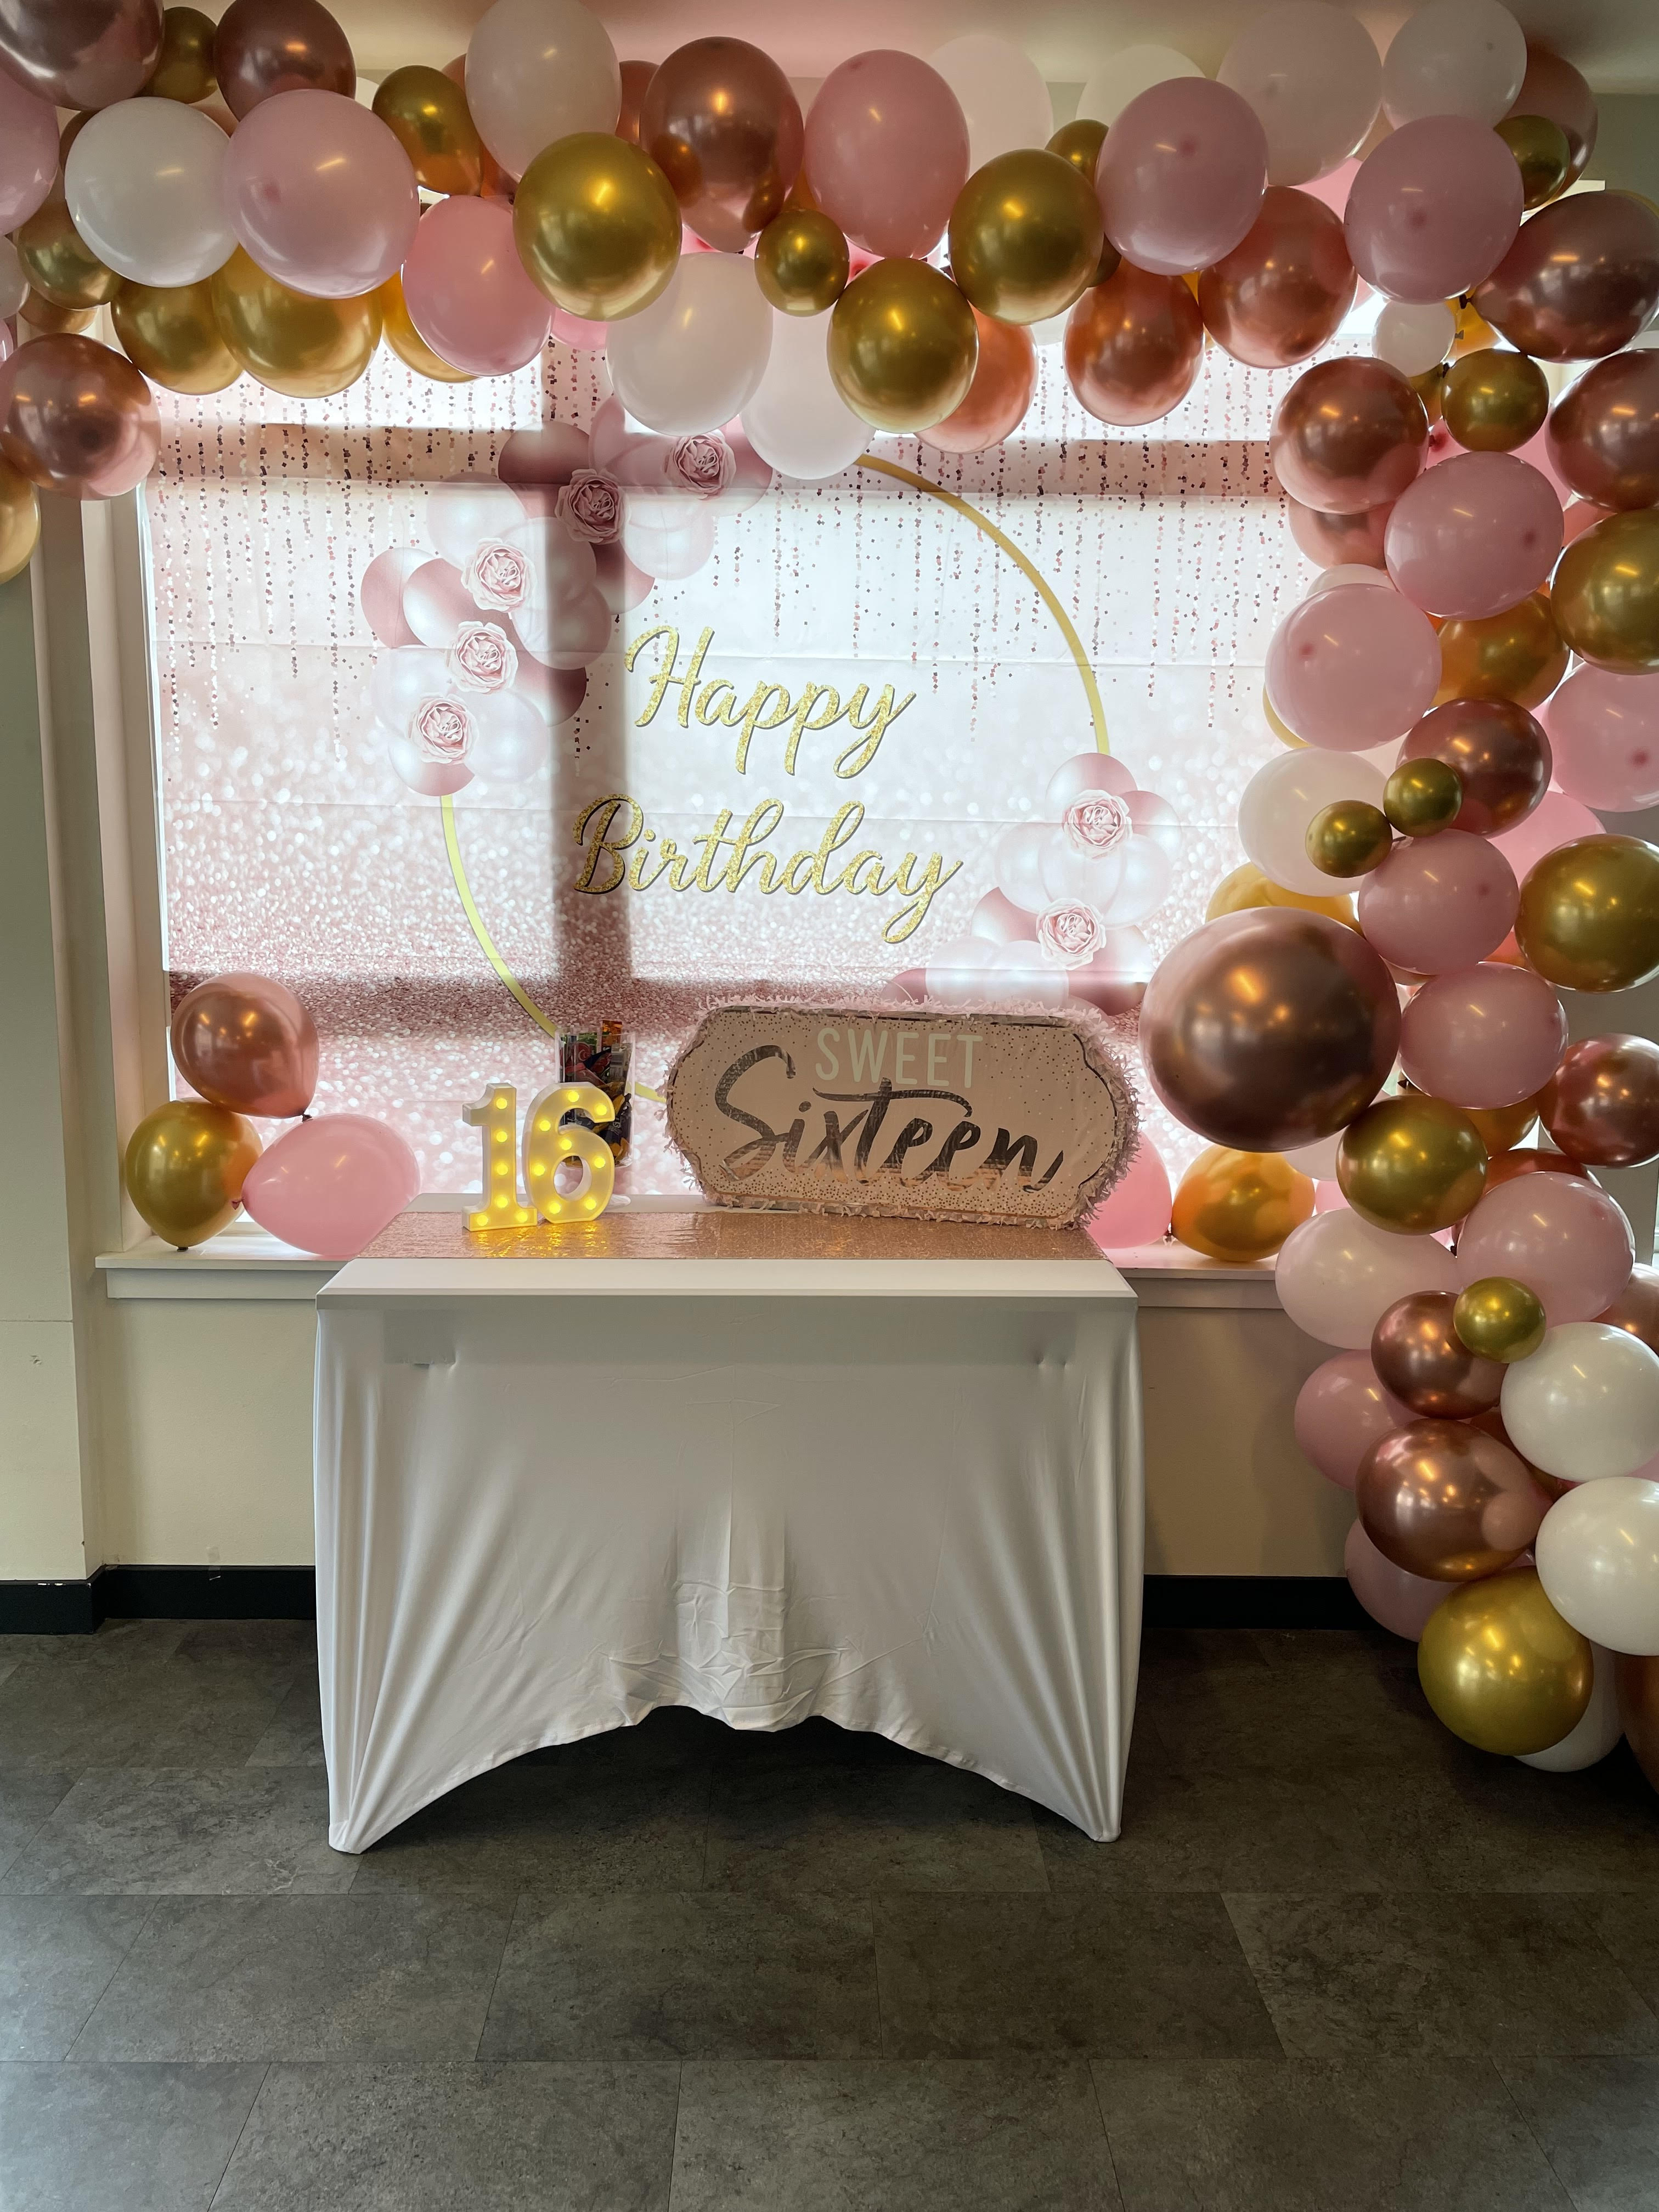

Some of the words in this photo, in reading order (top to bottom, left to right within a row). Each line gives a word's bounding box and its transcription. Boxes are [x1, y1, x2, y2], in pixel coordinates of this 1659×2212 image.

[624, 625, 916, 778] Happy
[573, 793, 963, 944] Birthday
[714, 1044, 1064, 1193] Sixteen
[815, 1027, 983, 1088] SWEET
[462, 1081, 616, 1232] 16
